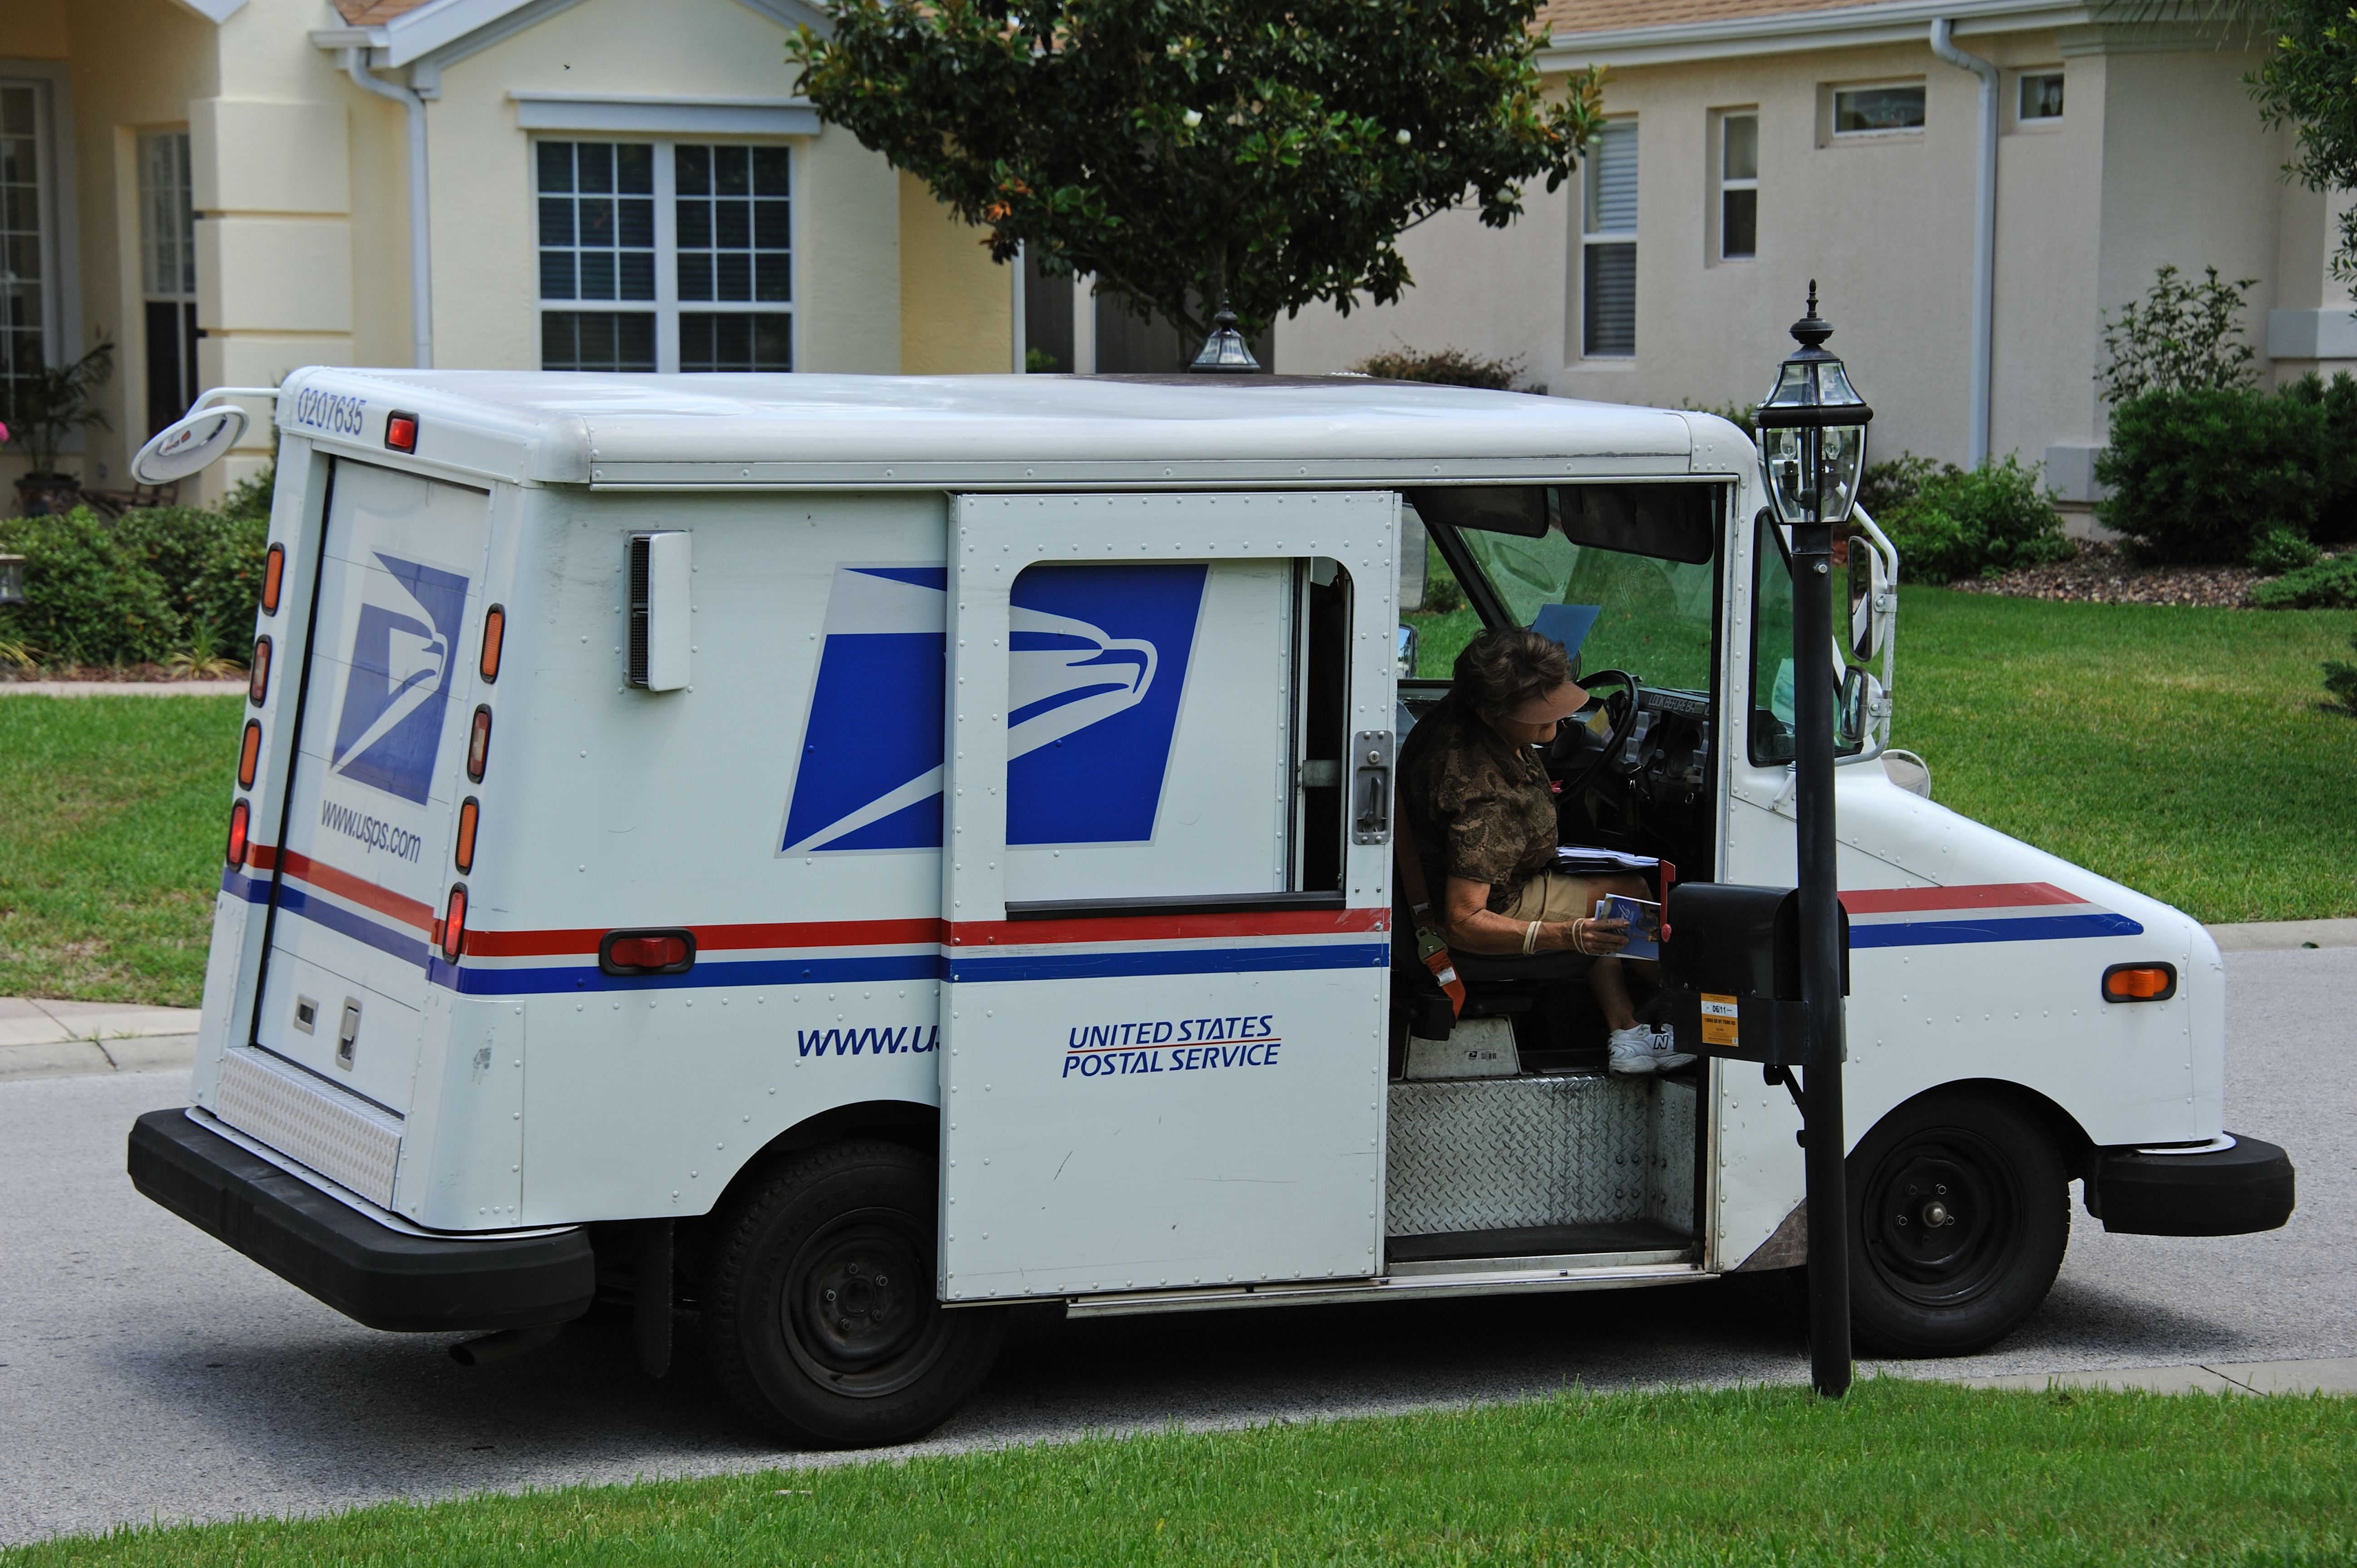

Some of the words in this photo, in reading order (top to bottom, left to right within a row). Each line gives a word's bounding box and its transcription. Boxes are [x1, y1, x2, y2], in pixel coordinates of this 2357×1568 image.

[298, 388, 367, 435] 0207635
[1648, 694, 1665, 707] LOOK
[1664, 697, 1687, 711] BEFORE
[322, 800, 421, 863] www.usps.com
[798, 1025, 940, 1057] www.u
[1069, 1021, 1173, 1048] UNITED
[1177, 1015, 1273, 1042] STATES
[1653, 1035, 1668, 1049] N
[1062, 1051, 1164, 1078] POSTAL
[1169, 1044, 1281, 1071] SERVICE
